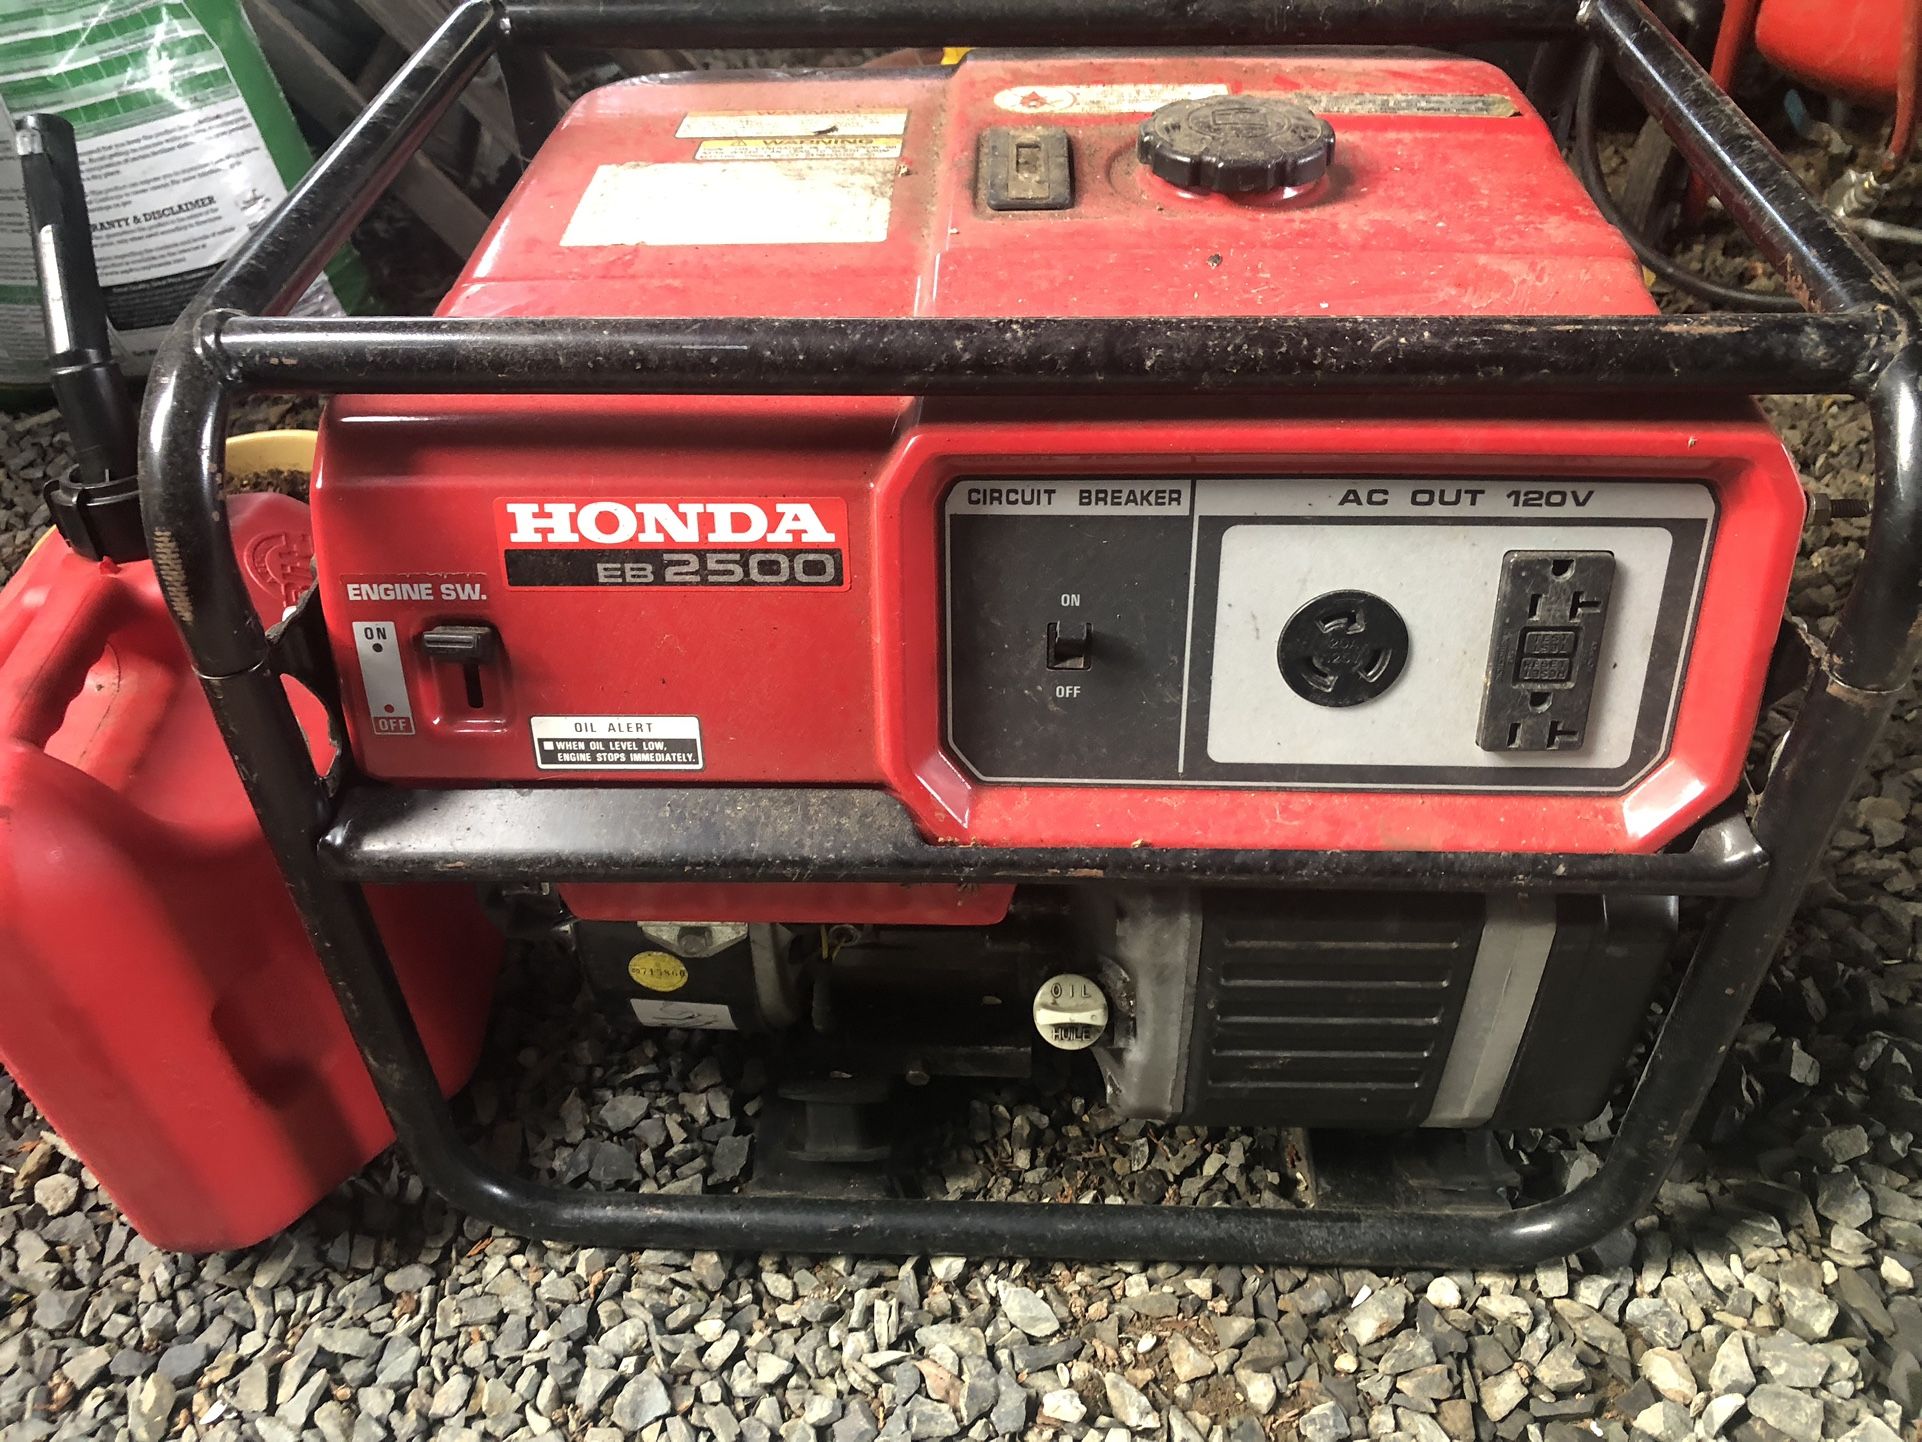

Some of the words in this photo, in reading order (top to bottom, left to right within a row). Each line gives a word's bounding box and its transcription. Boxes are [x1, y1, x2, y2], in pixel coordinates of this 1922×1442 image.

[762, 138, 874, 146] WARNING
[133, 215, 142, 225] &
[144, 195, 217, 222] DISCLAIMER
[967, 488, 1057, 506] CIRCUIT
[1078, 488, 1182, 506] BREAKER
[1338, 488, 1389, 507] AC
[1410, 488, 1486, 507] OUT
[1505, 489, 1595, 508] 120V
[506, 502, 836, 543] HONDA
[597, 562, 655, 583] EB
[663, 552, 836, 583] 2500
[347, 583, 434, 601] ENGINE
[440, 583, 488, 601] SW.
[1061, 593, 1081, 607] ON
[364, 627, 388, 640] ON
[1055, 685, 1081, 698] OFF
[378, 718, 407, 731] OFF
[574, 722, 597, 733] OIL
[607, 722, 653, 733] ALERT
[556, 741, 585, 750] WHEN
[589, 741, 605, 750] OIL
[609, 741, 638, 750] LEVEL
[643, 741, 667, 751] LOW,
[557, 752, 592, 762] ENGINE
[596, 752, 626, 762] STOPS
[630, 752, 696, 762] IMMEDIATELY.
[1051, 982, 1092, 999] OIL
[1052, 1026, 1091, 1041] HUILE
